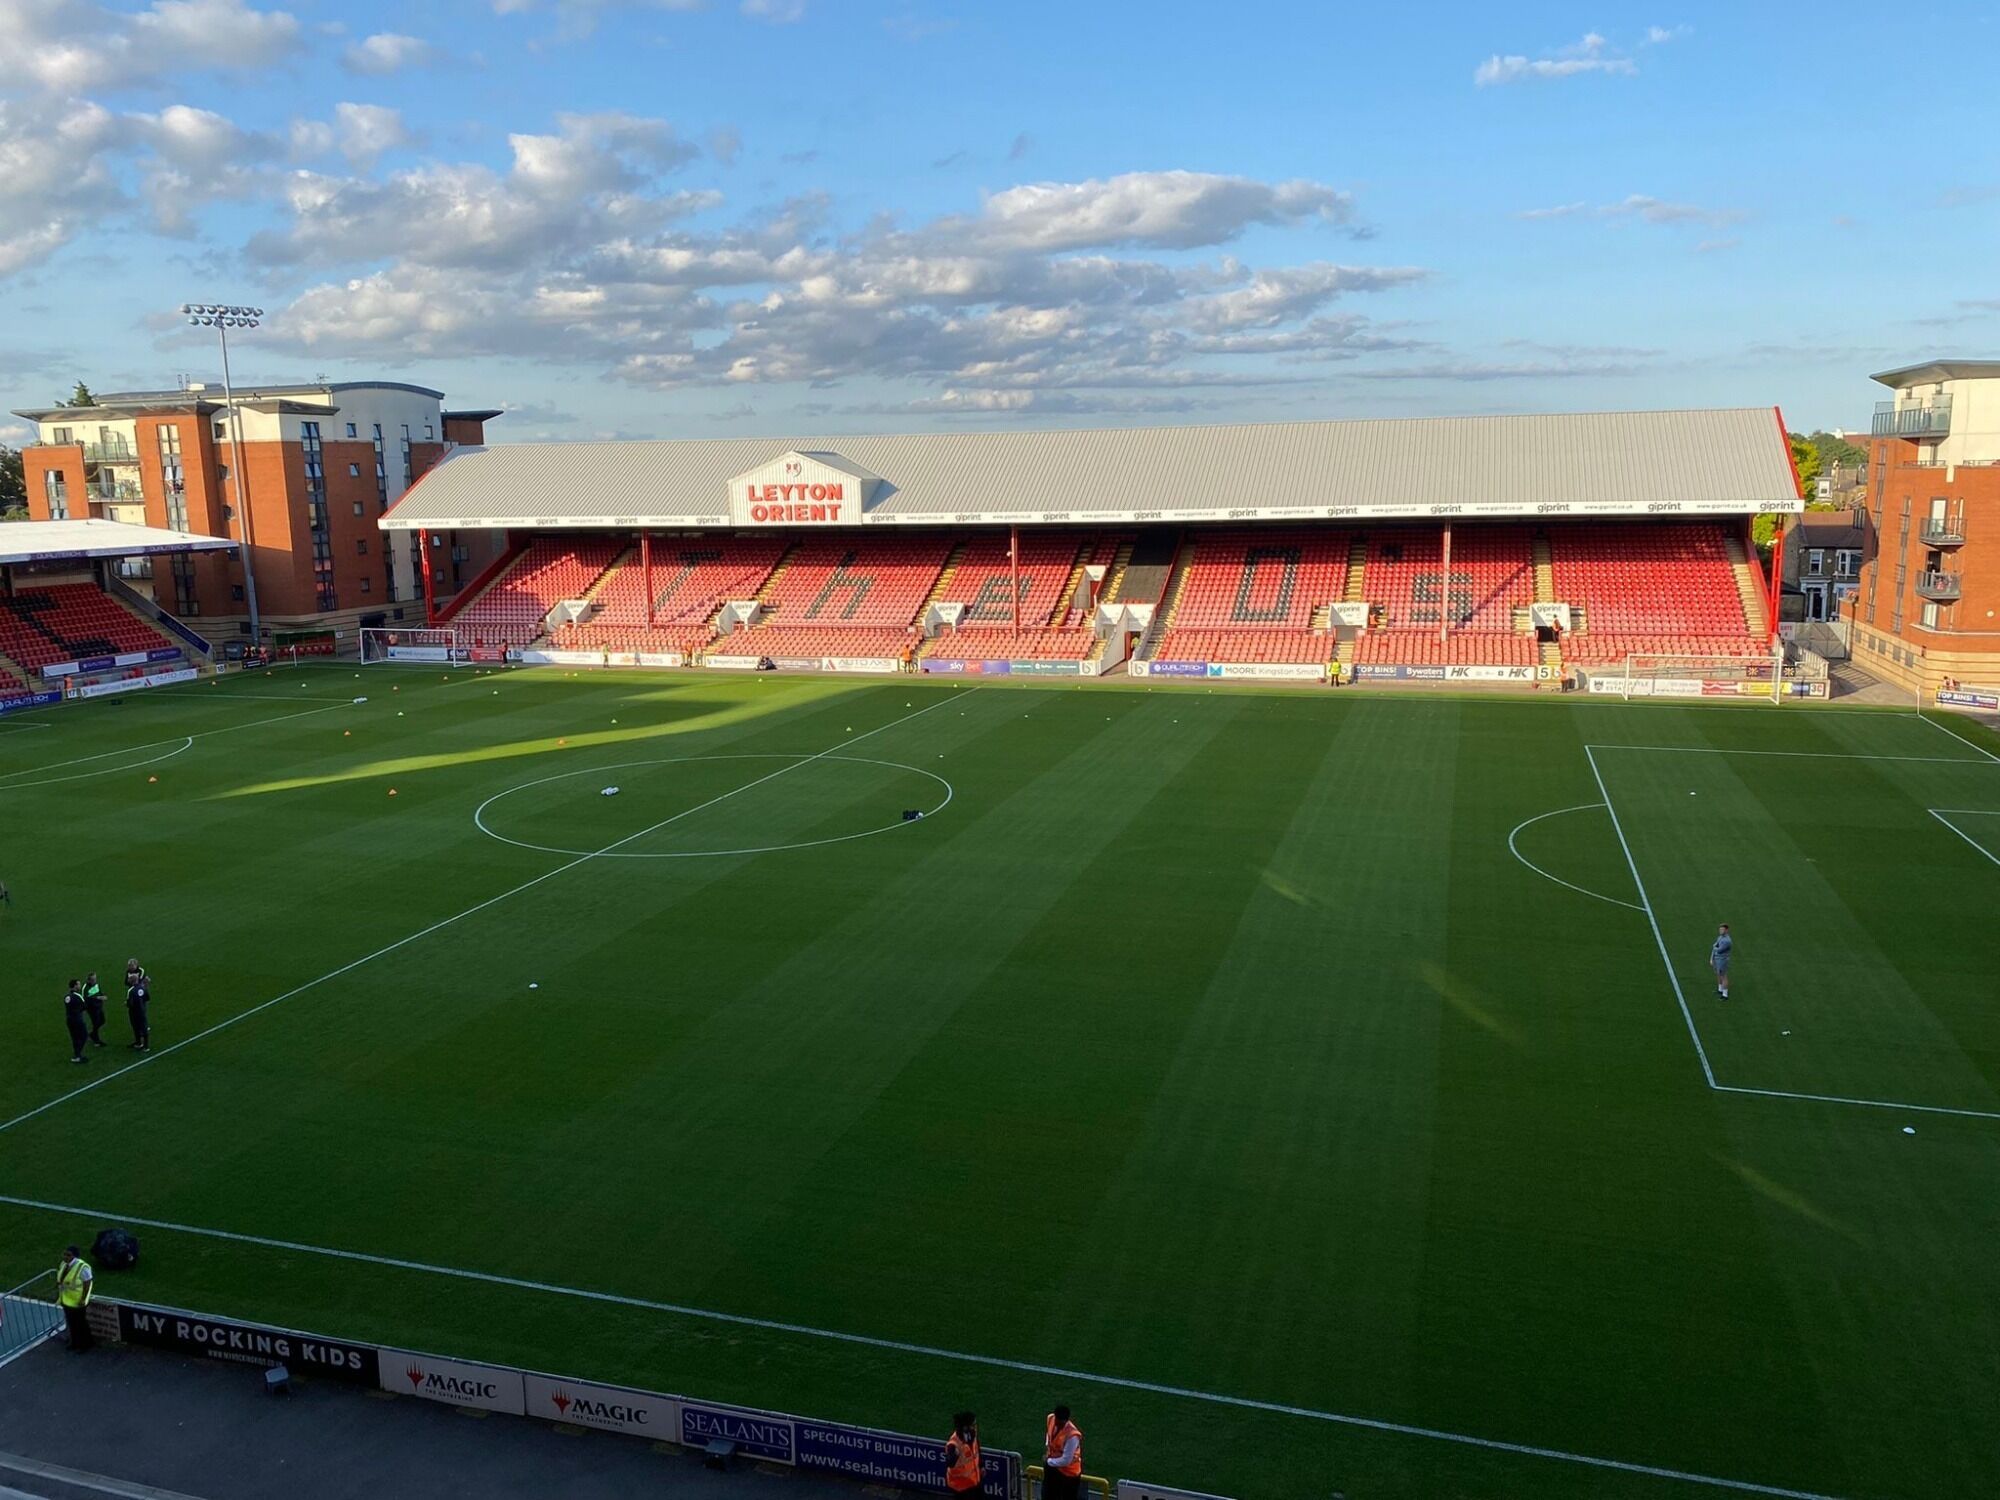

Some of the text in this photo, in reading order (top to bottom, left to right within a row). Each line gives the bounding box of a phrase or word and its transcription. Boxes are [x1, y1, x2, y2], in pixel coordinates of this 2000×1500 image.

[748, 483, 843, 502] LEYTON
[696, 516, 720, 525] giprint
[871, 513, 896, 522] giprint
[955, 513, 981, 522] giprint
[1043, 512, 1070, 521] giprint
[1133, 511, 1162, 520] giprint
[1228, 509, 1258, 518] giprint
[1327, 506, 1358, 516] giprint
[1430, 505, 1462, 514] giprint
[1537, 502, 1570, 512] giprint
[1647, 501, 1681, 512] giprint
[1759, 501, 1795, 511] giprint
[751, 504, 841, 522] ORIENT
[949, 662, 964, 671] sky
[1258, 668, 1294, 676] Kingston
[1406, 667, 1443, 676] Bywaters
[1540, 667, 1549, 678] 5
[133, 1312, 166, 1335] MY
[177, 1321, 290, 1357] ROCKING
[302, 1342, 362, 1370] KIDS
[425, 1373, 497, 1399] MAGIC
[572, 1399, 648, 1425] MAGIC
[684, 1412, 789, 1445] SEALANTS
[803, 1428, 871, 1450] SPECIALIST
[874, 1441, 934, 1460] BUILDING
[800, 1451, 1004, 1497] www.sealantsonlinuk
